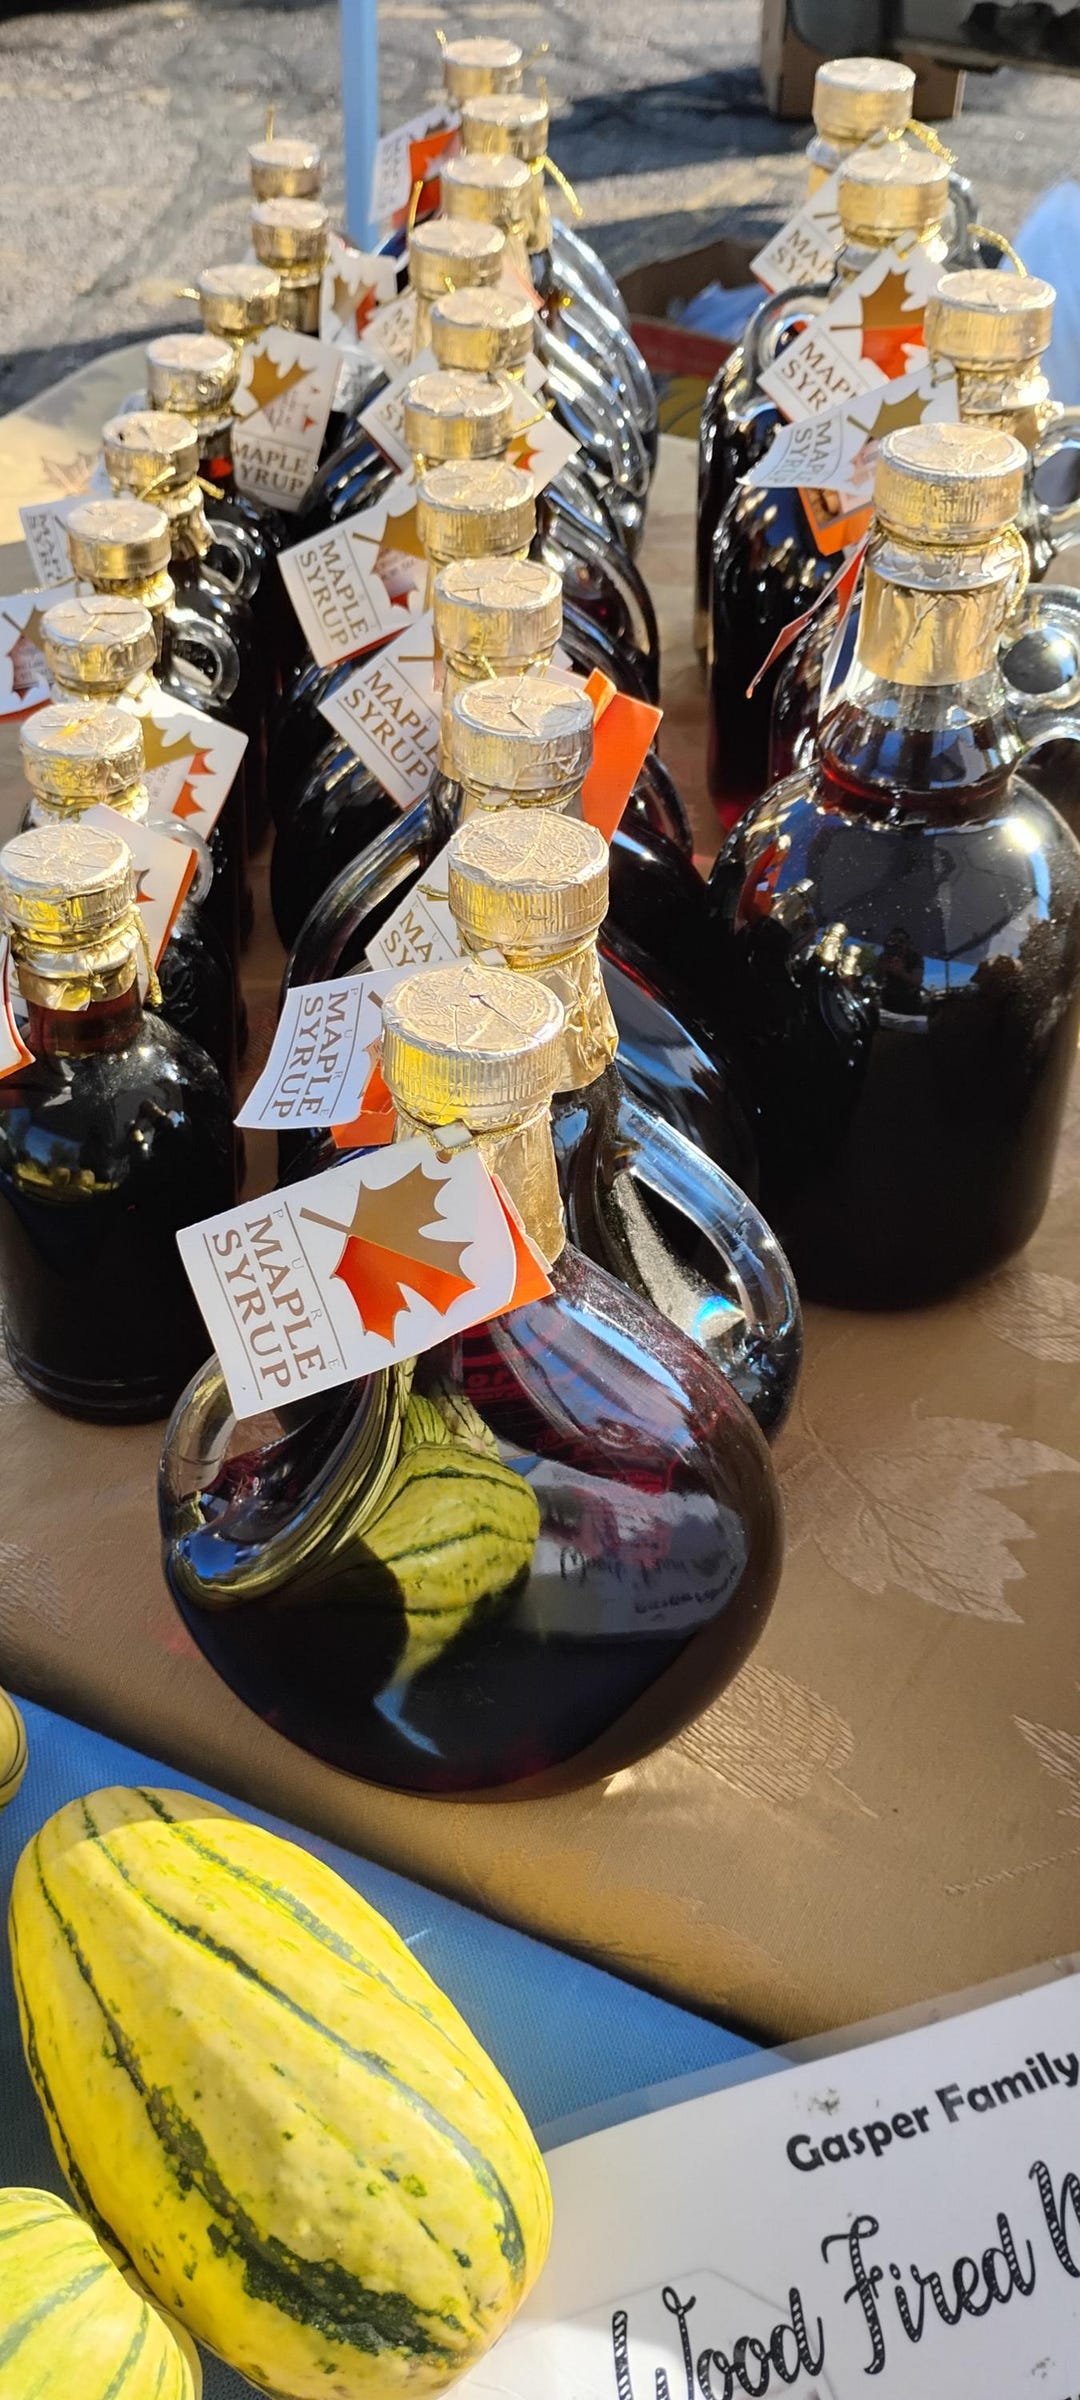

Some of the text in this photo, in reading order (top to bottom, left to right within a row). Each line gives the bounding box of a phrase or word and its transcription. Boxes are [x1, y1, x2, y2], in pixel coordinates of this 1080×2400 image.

[781, 358, 828, 411] SYR
[800, 341, 857, 400] MAP
[240, 463, 306, 493] YRUP
[300, 550, 350, 646] SYRUP
[319, 539, 370, 640] MAPLE
[343, 687, 429, 780] SYRUP
[272, 995, 324, 1118] SYRUP
[296, 989, 350, 1117] MAPLE
[212, 1228, 290, 1388] SYRUP
[244, 1214, 326, 1382] MAPLE
[272, 1207, 340, 1370] PURE
[786, 2051, 1080, 2172] Gasper Family
[612, 2286, 825, 2400] Wood
[820, 2212, 1036, 2375] Fired
